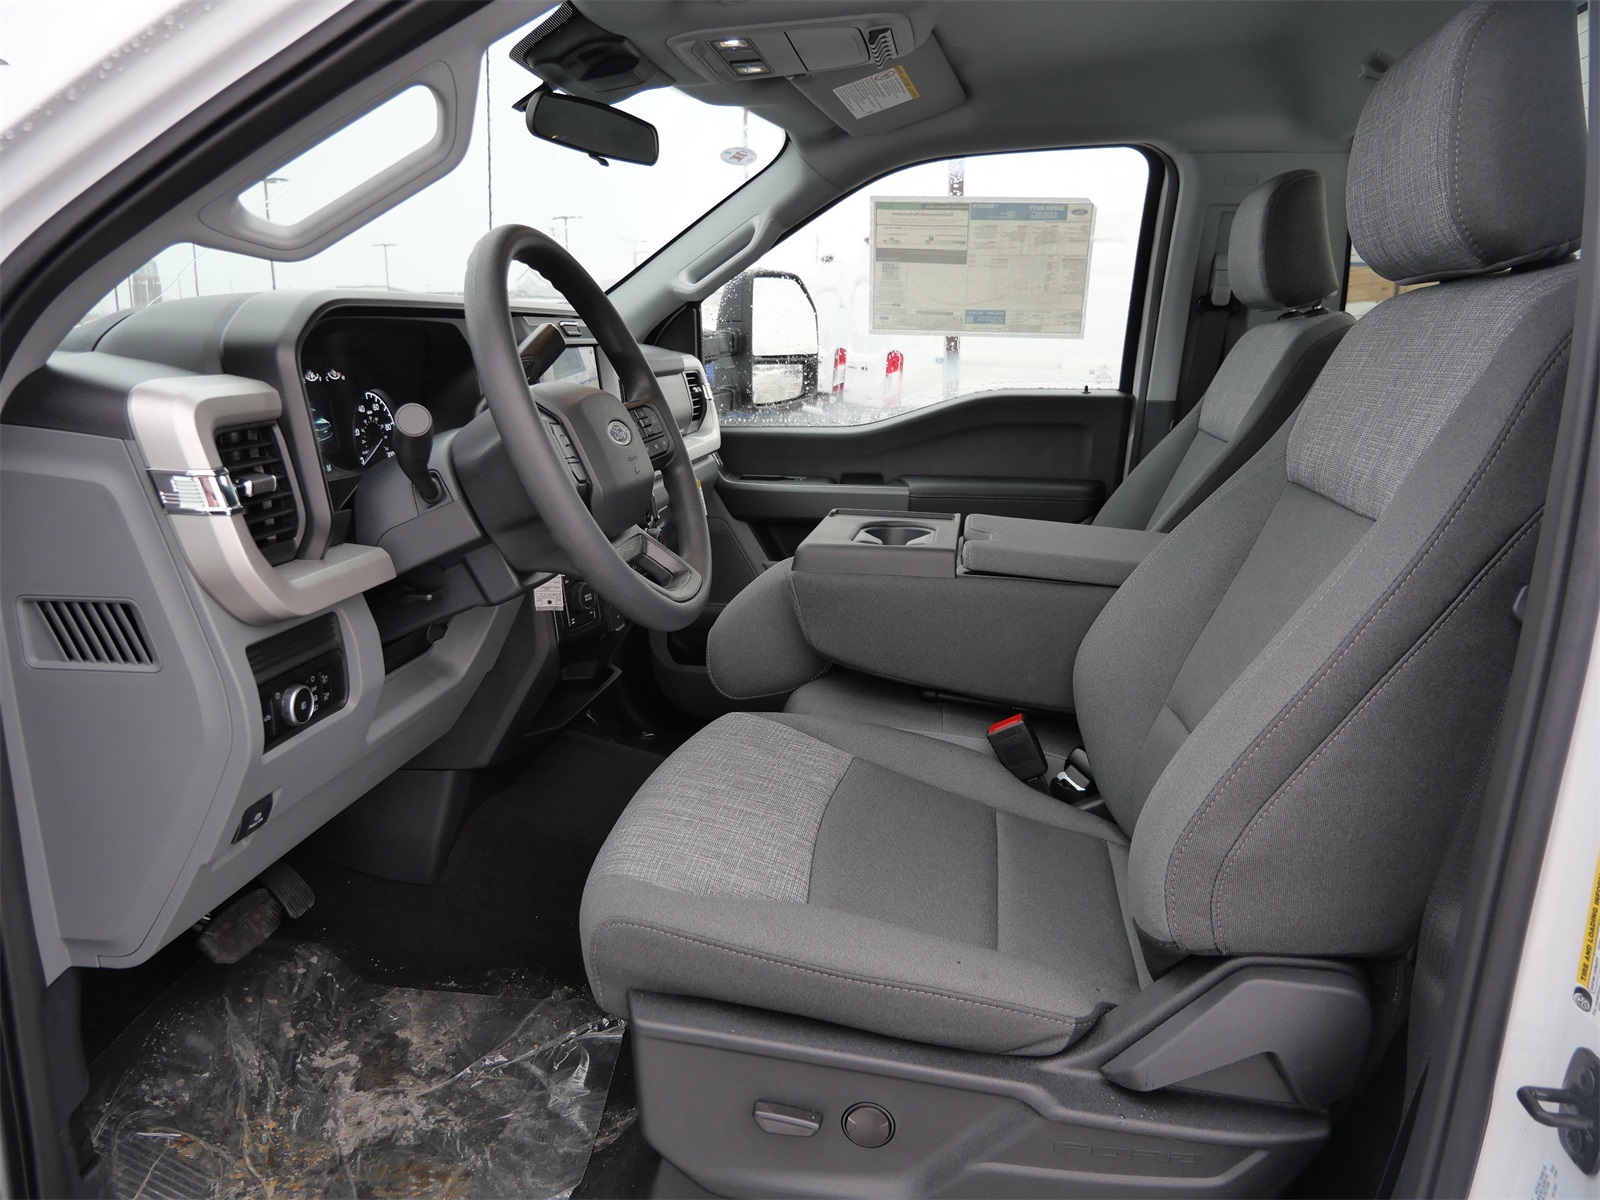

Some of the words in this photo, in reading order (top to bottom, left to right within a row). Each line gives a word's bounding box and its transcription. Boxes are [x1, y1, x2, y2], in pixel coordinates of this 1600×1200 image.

[1587, 906, 1599, 944] LOADING
[1584, 944, 1593, 963] AND
[1580, 962, 1590, 982] TIRE
[1053, 1140, 1203, 1163] FORD
